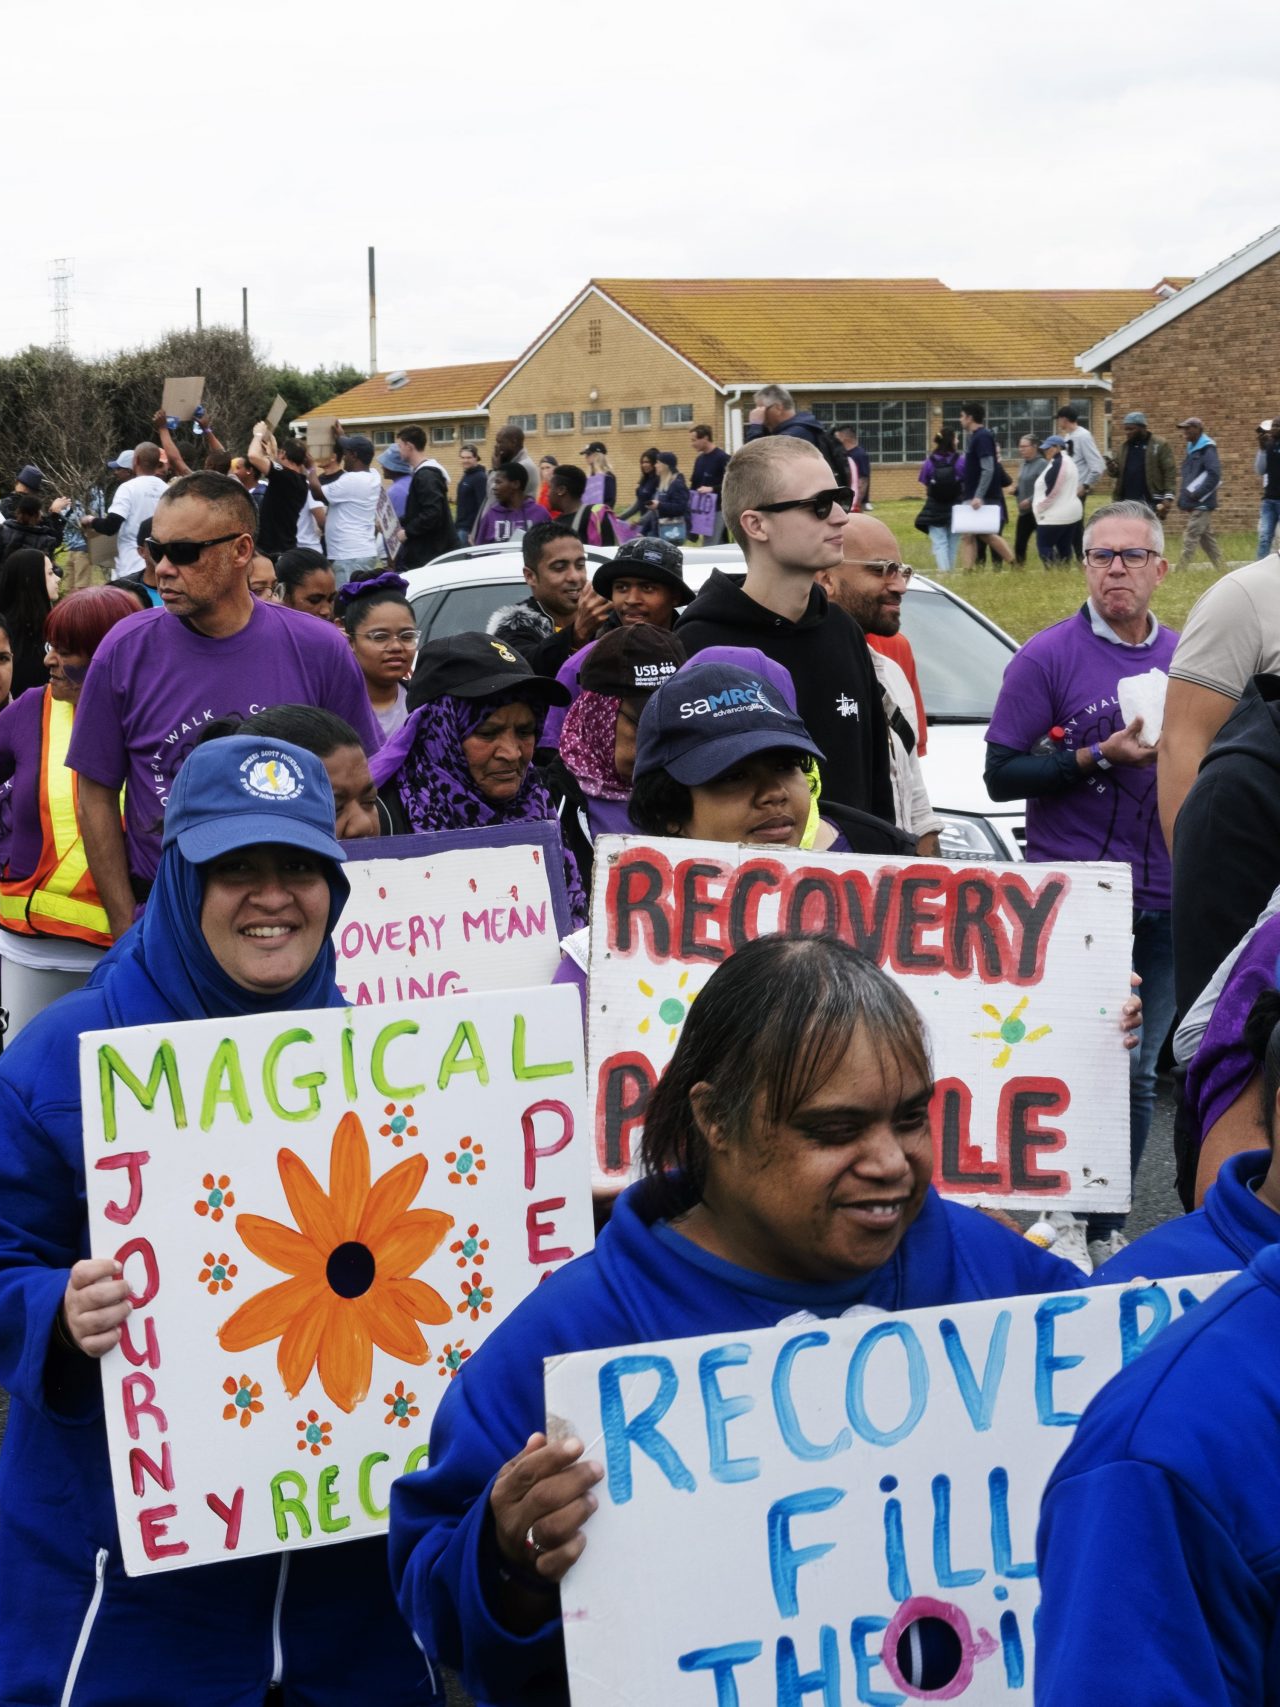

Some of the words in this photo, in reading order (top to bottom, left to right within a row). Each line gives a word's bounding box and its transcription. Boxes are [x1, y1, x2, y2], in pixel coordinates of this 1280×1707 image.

[634, 665, 658, 676] USB
[165, 709, 214, 744] WALK
[336, 913, 446, 959] OVERY
[462, 901, 547, 944] MEAN
[605, 846, 1072, 987] RECOVERY
[97, 1013, 575, 1143] MAGICAL
[598, 1285, 1205, 1505] RECOVER
